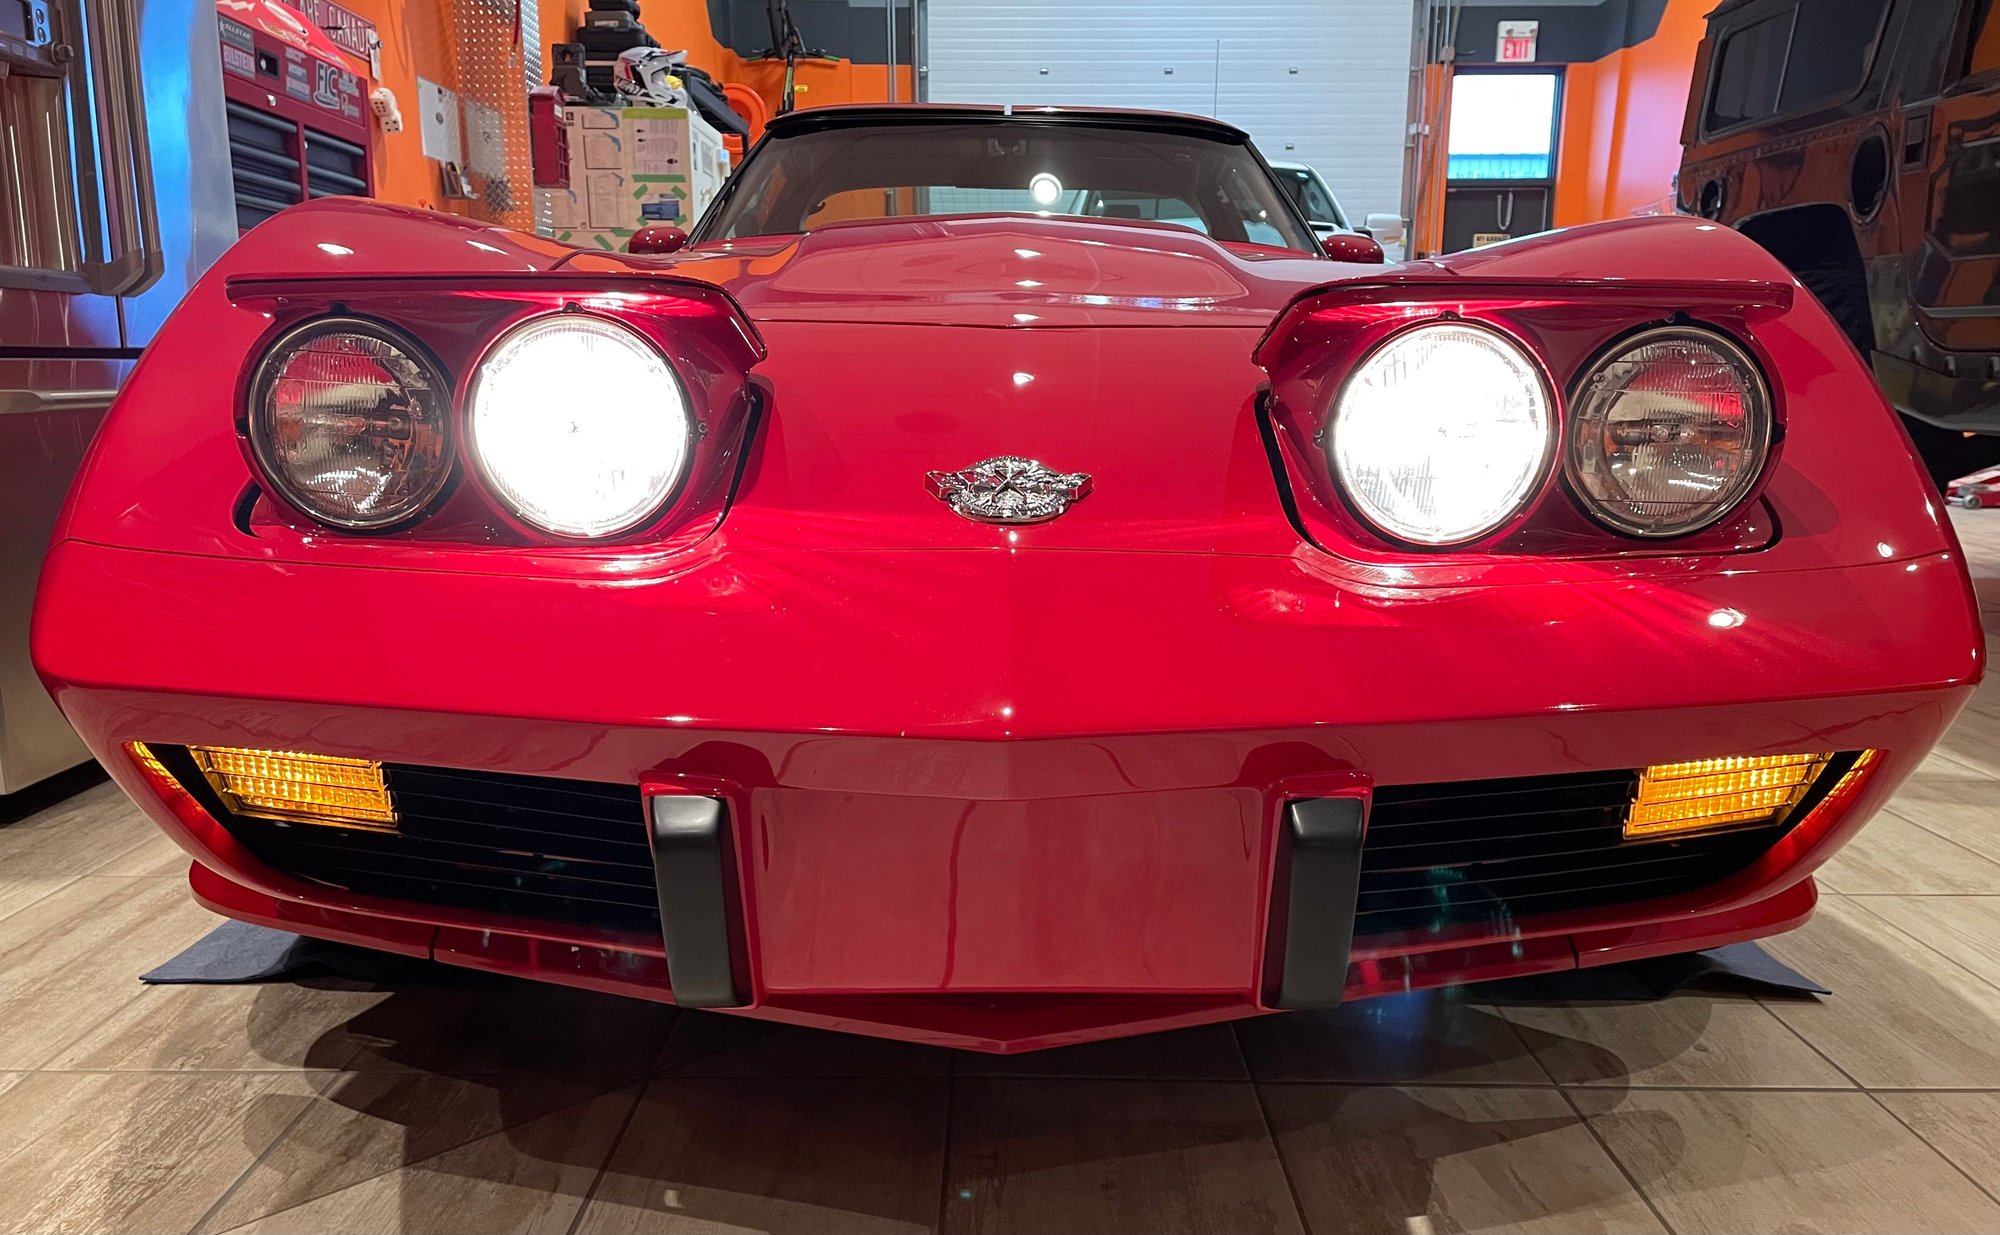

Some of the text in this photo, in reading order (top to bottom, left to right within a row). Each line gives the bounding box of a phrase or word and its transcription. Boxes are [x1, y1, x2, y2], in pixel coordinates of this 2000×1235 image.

[225, 22, 251, 40] ALLSTAR
[1503, 38, 1531, 59] EXIT
[317, 62, 338, 98] FIC
